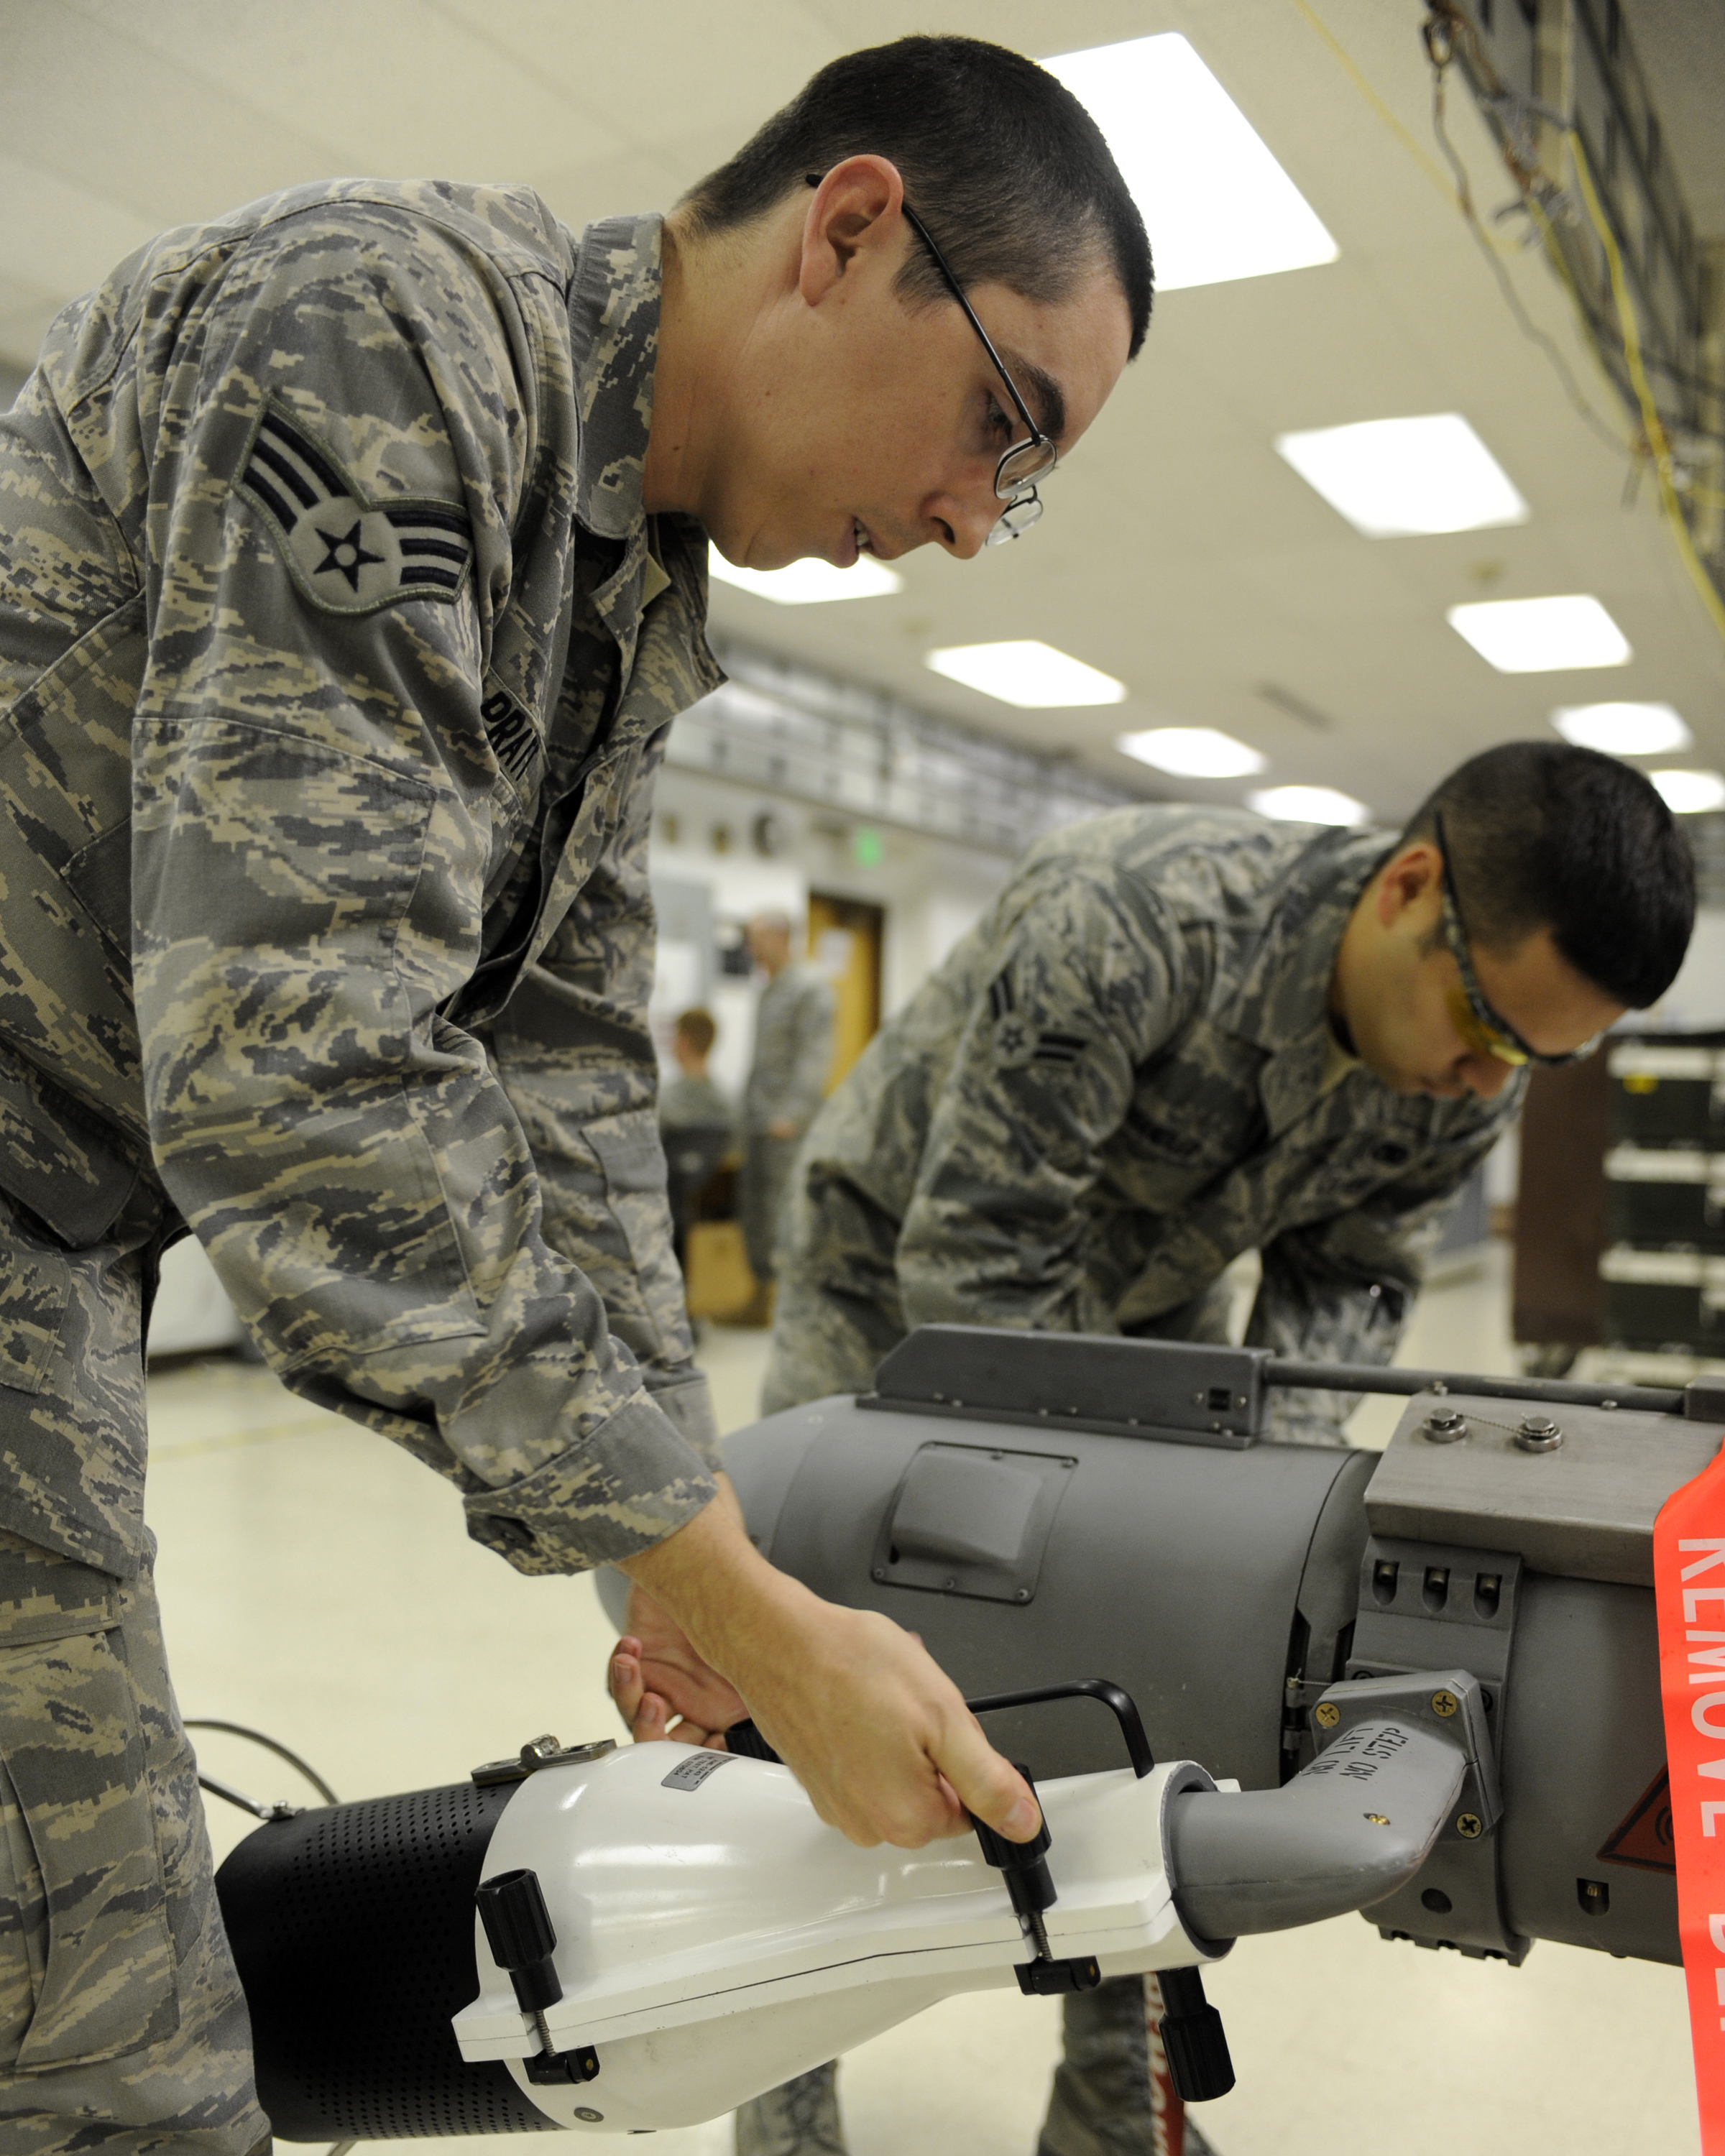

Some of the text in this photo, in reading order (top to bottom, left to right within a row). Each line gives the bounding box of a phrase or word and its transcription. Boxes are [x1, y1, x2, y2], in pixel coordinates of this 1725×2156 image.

[1678, 1538, 1725, 1837] REM
[1302, 1760, 1340, 1777] NO
[1338, 1727, 1409, 1781] NO STEP
[681, 1769, 694, 1779] HAT
